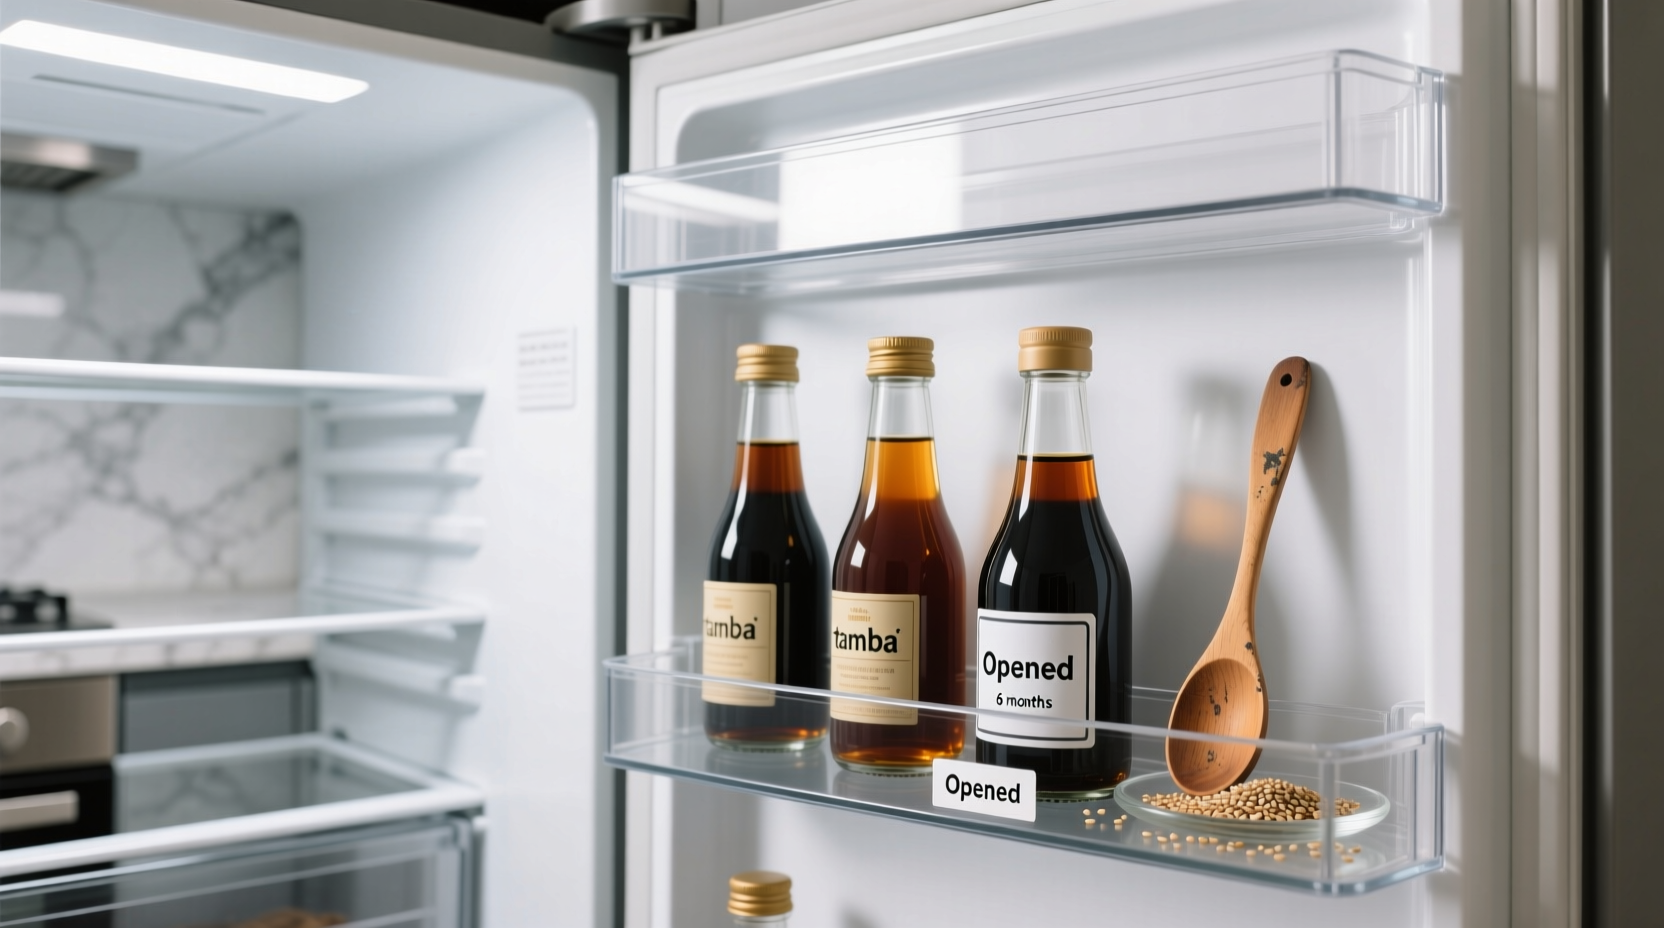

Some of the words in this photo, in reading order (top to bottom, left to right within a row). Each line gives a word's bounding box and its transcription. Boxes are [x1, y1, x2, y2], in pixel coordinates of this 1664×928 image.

[983, 650, 1074, 683] Opened
[996, 693, 1003, 706] 6
[1006, 695, 1053, 709] months
[945, 773, 1021, 804] Opened
